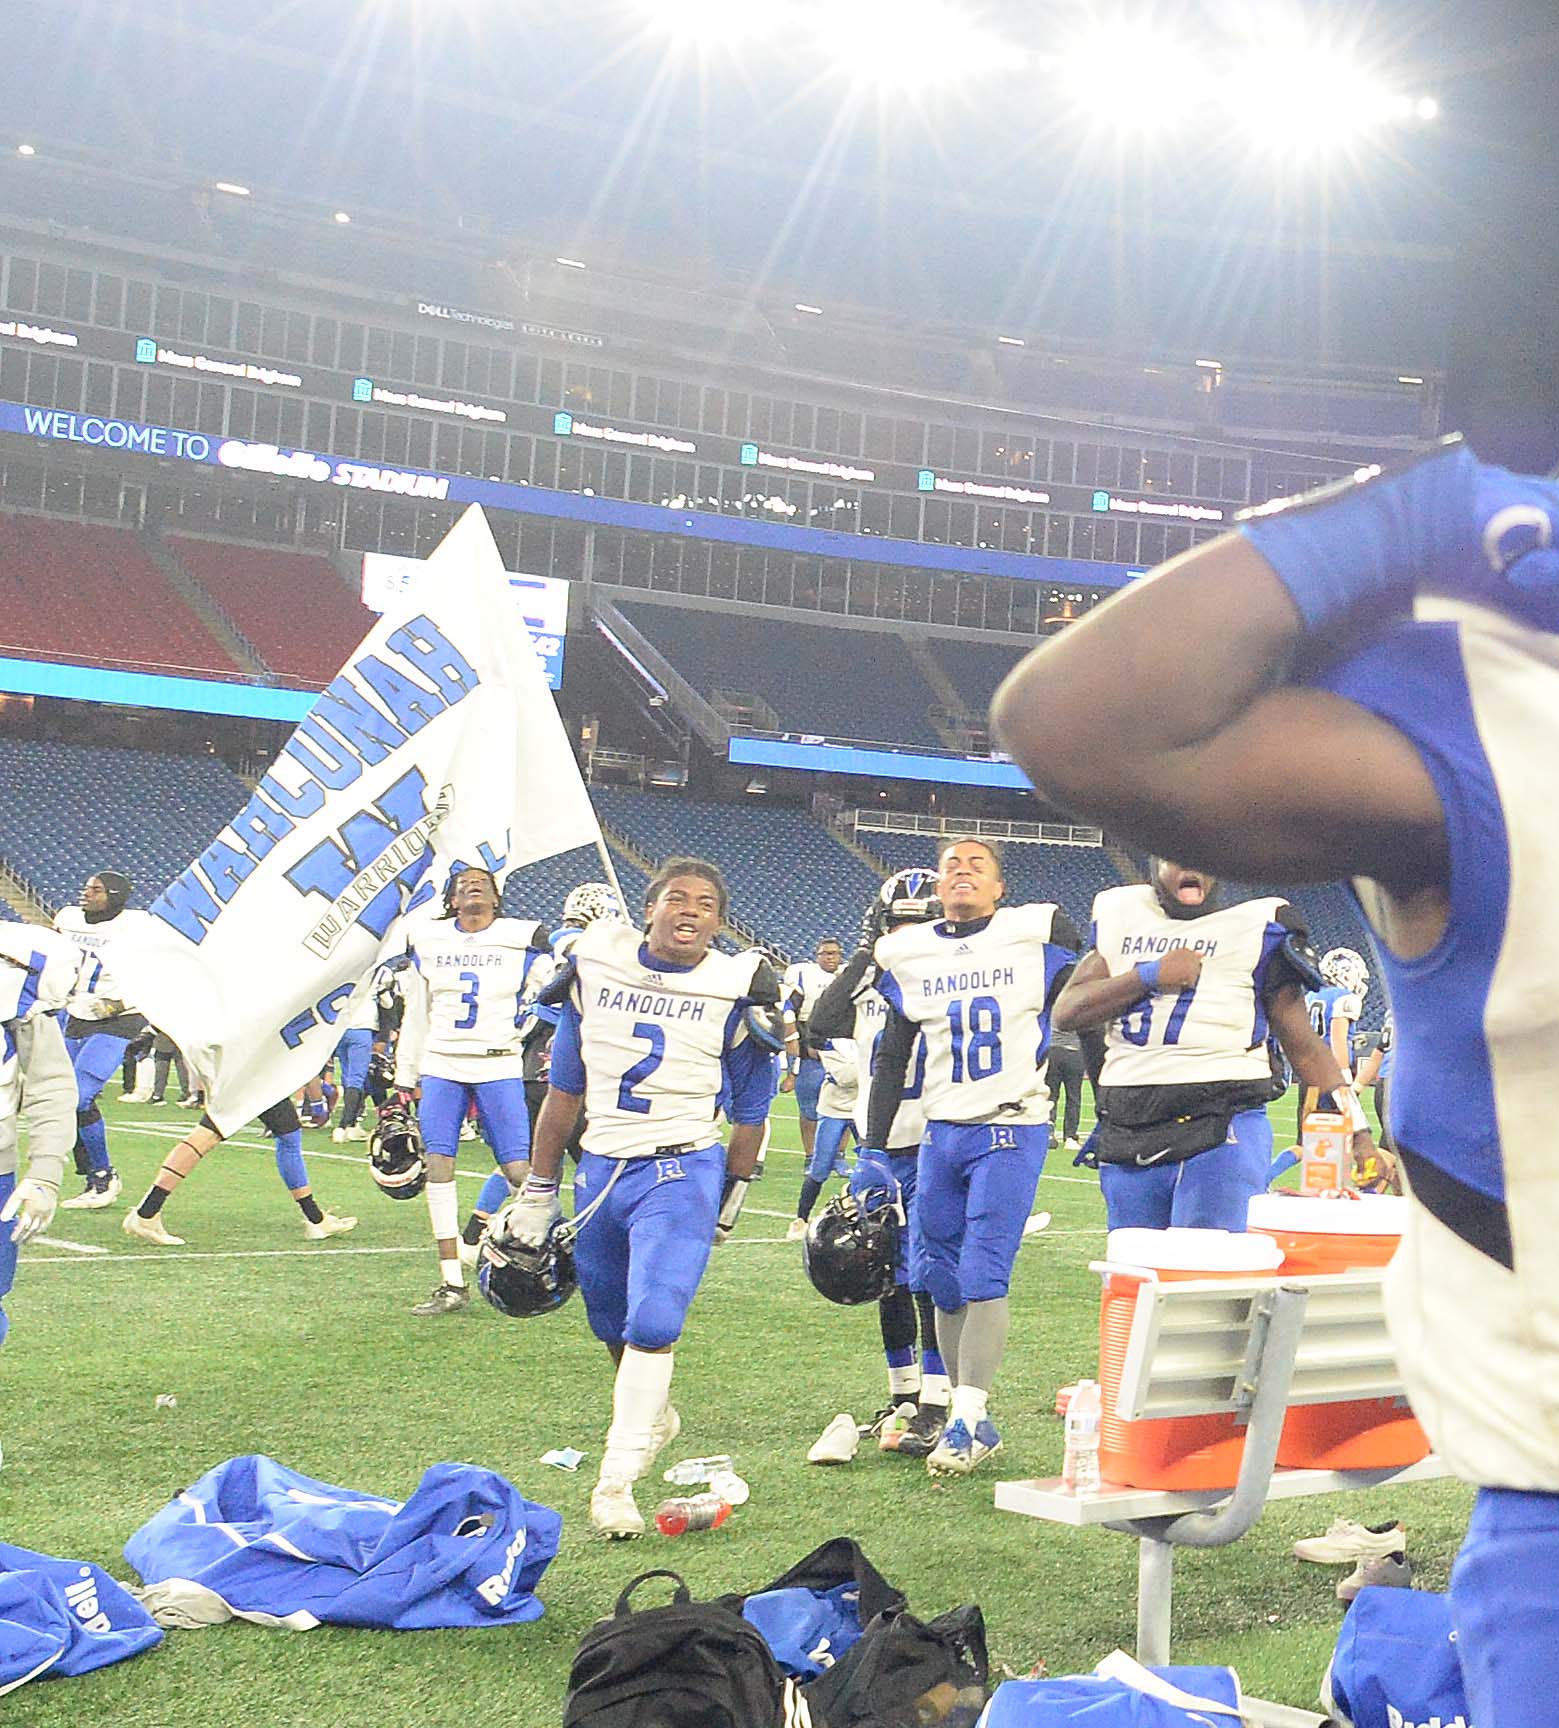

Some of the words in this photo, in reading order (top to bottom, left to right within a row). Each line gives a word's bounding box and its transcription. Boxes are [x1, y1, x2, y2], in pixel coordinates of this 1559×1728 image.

[24, 407, 166, 455] WELCOME
[172, 432, 209, 460] TO
[332, 463, 450, 501] STADIUM
[312, 792, 449, 949] WARRIO
[436, 954, 503, 969] RANDOLPH
[922, 966, 1015, 997] RANDOLPH
[454, 971, 481, 1030] 3
[598, 987, 706, 1022] RANDOLPH
[947, 995, 1003, 1084] 18
[617, 1022, 666, 1114] 2
[989, 1126, 1017, 1150] R
[656, 1158, 687, 1185] R
